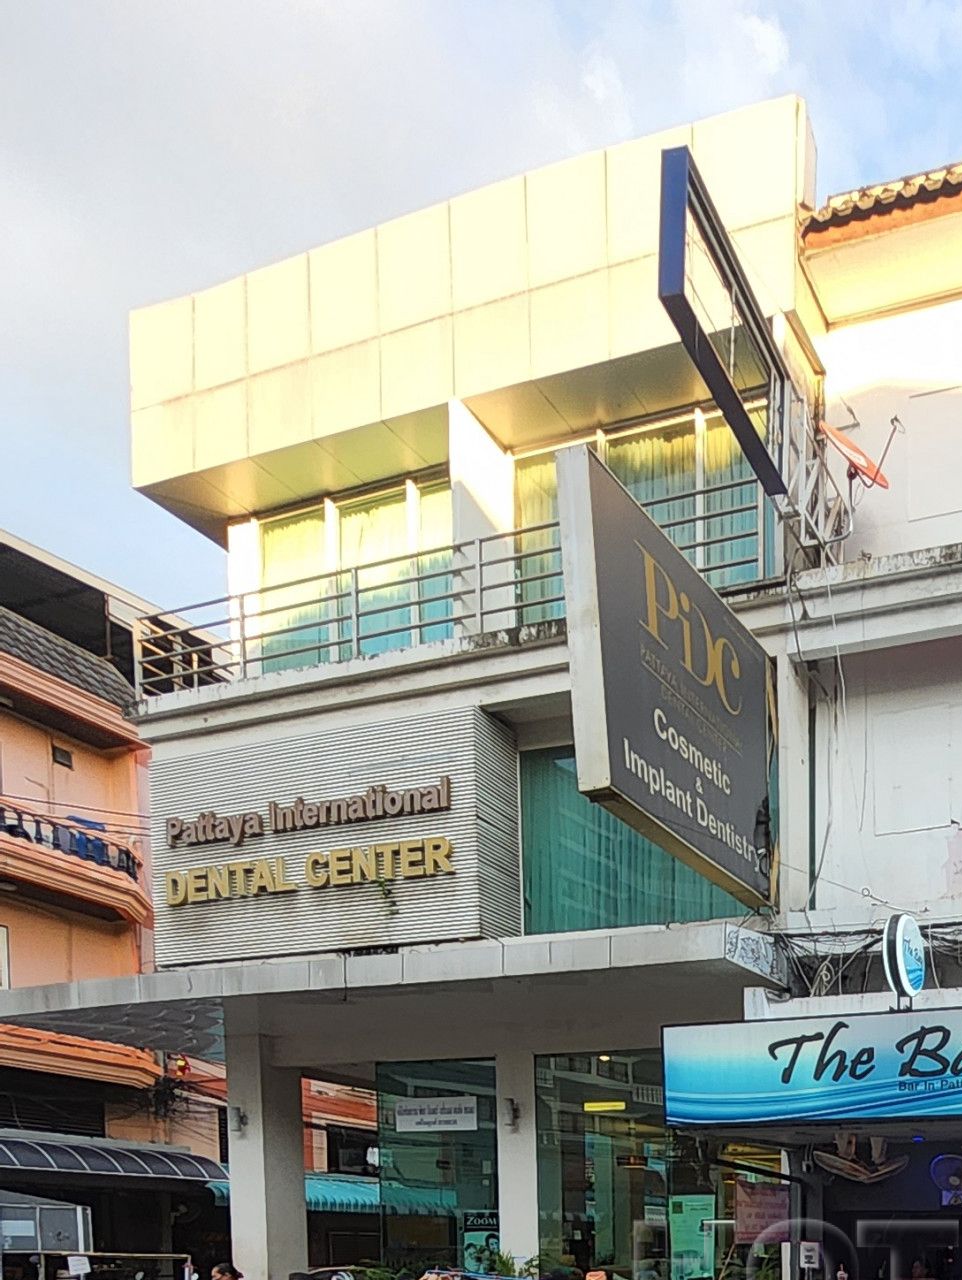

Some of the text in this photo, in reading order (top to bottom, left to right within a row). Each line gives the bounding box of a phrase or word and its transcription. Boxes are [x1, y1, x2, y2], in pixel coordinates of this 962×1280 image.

[654, 708, 731, 795] Cosmetic
[695, 776, 704, 794] &
[165, 775, 453, 848] Pattaya International
[624, 738, 766, 873] Implant Dentistry
[164, 836, 457, 907] DENTAL CENTER
[768, 1021, 875, 1084] The
[898, 1080, 918, 1092] Bar
[466, 1215, 497, 1226] ZOOM
